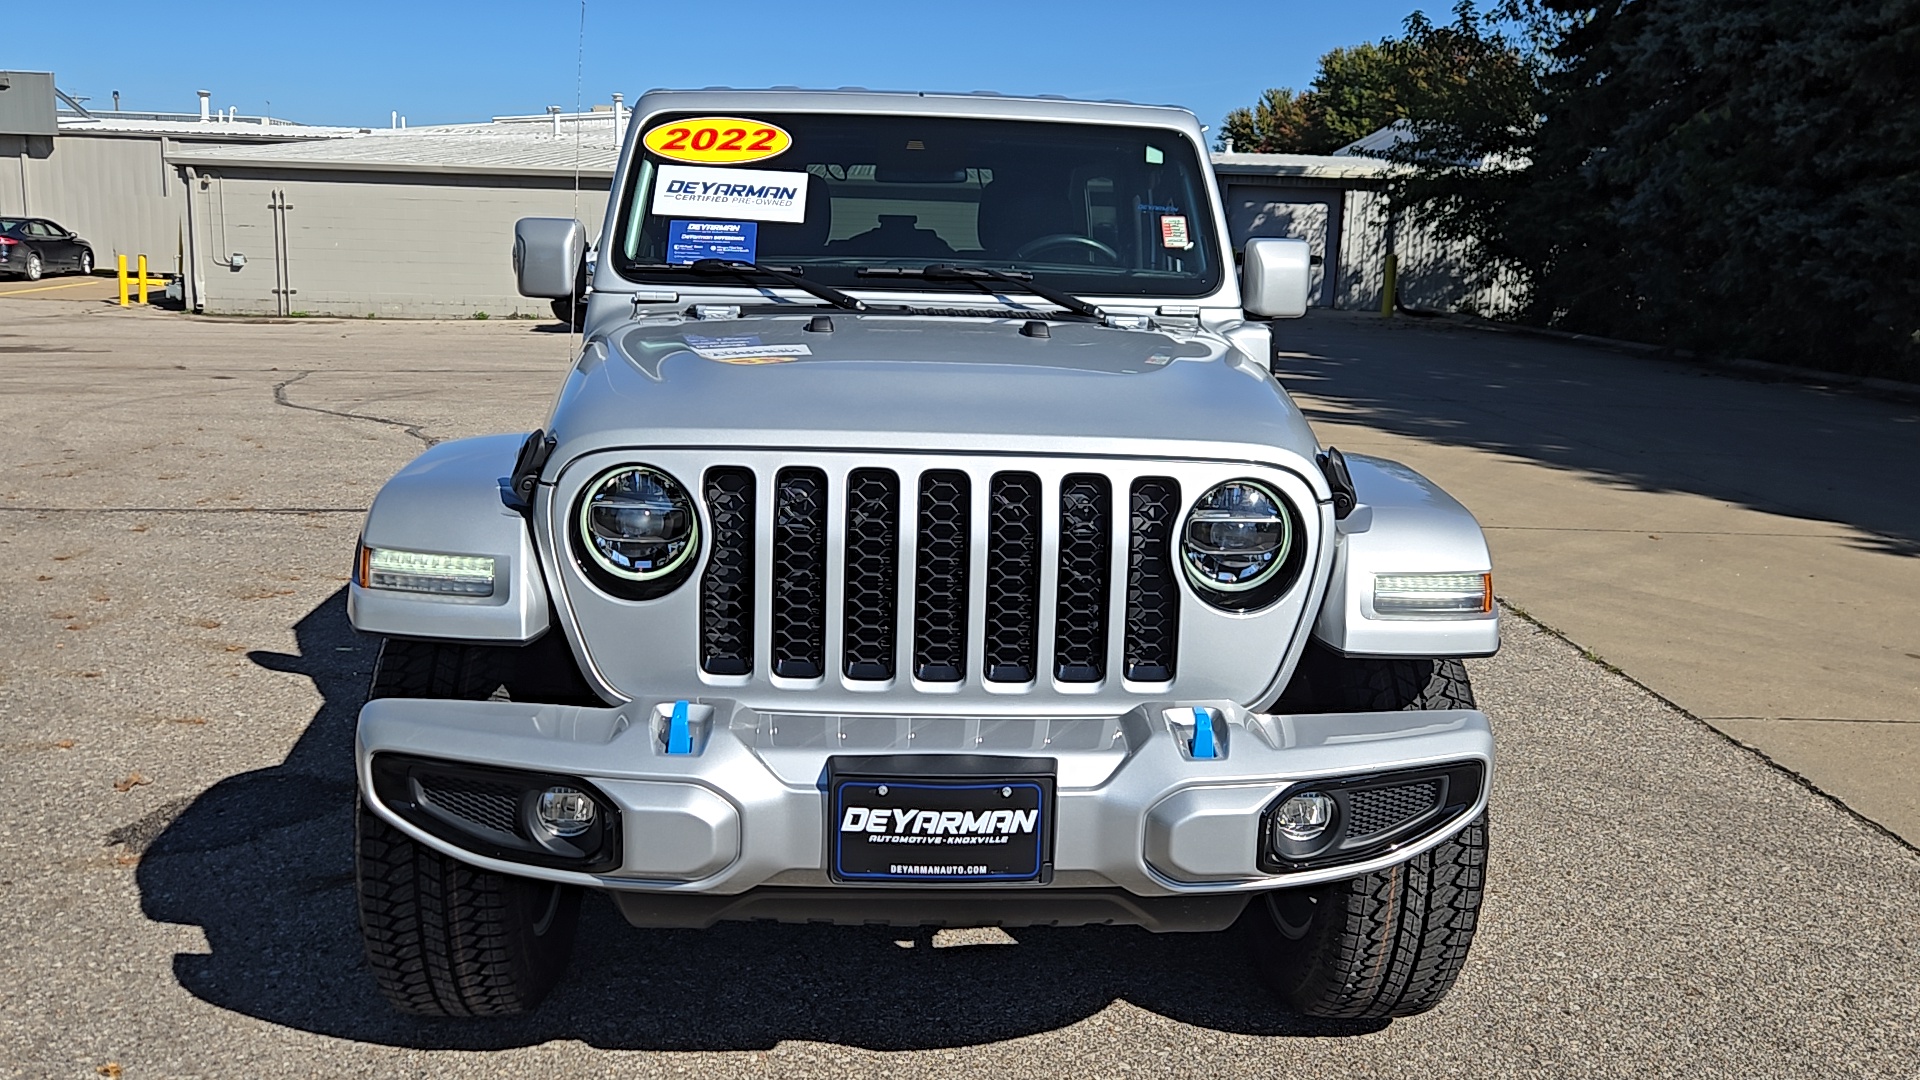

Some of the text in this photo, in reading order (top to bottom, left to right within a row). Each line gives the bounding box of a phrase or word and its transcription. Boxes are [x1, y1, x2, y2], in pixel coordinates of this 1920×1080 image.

[659, 127, 777, 151] 2022
[665, 180, 798, 200] DEYARMAN
[675, 194, 793, 207] CERTIFIED PRE-OWNED
[841, 806, 1038, 834] DEYARMAN
[890, 864, 987, 875] DEYARMANAUTO.COM
